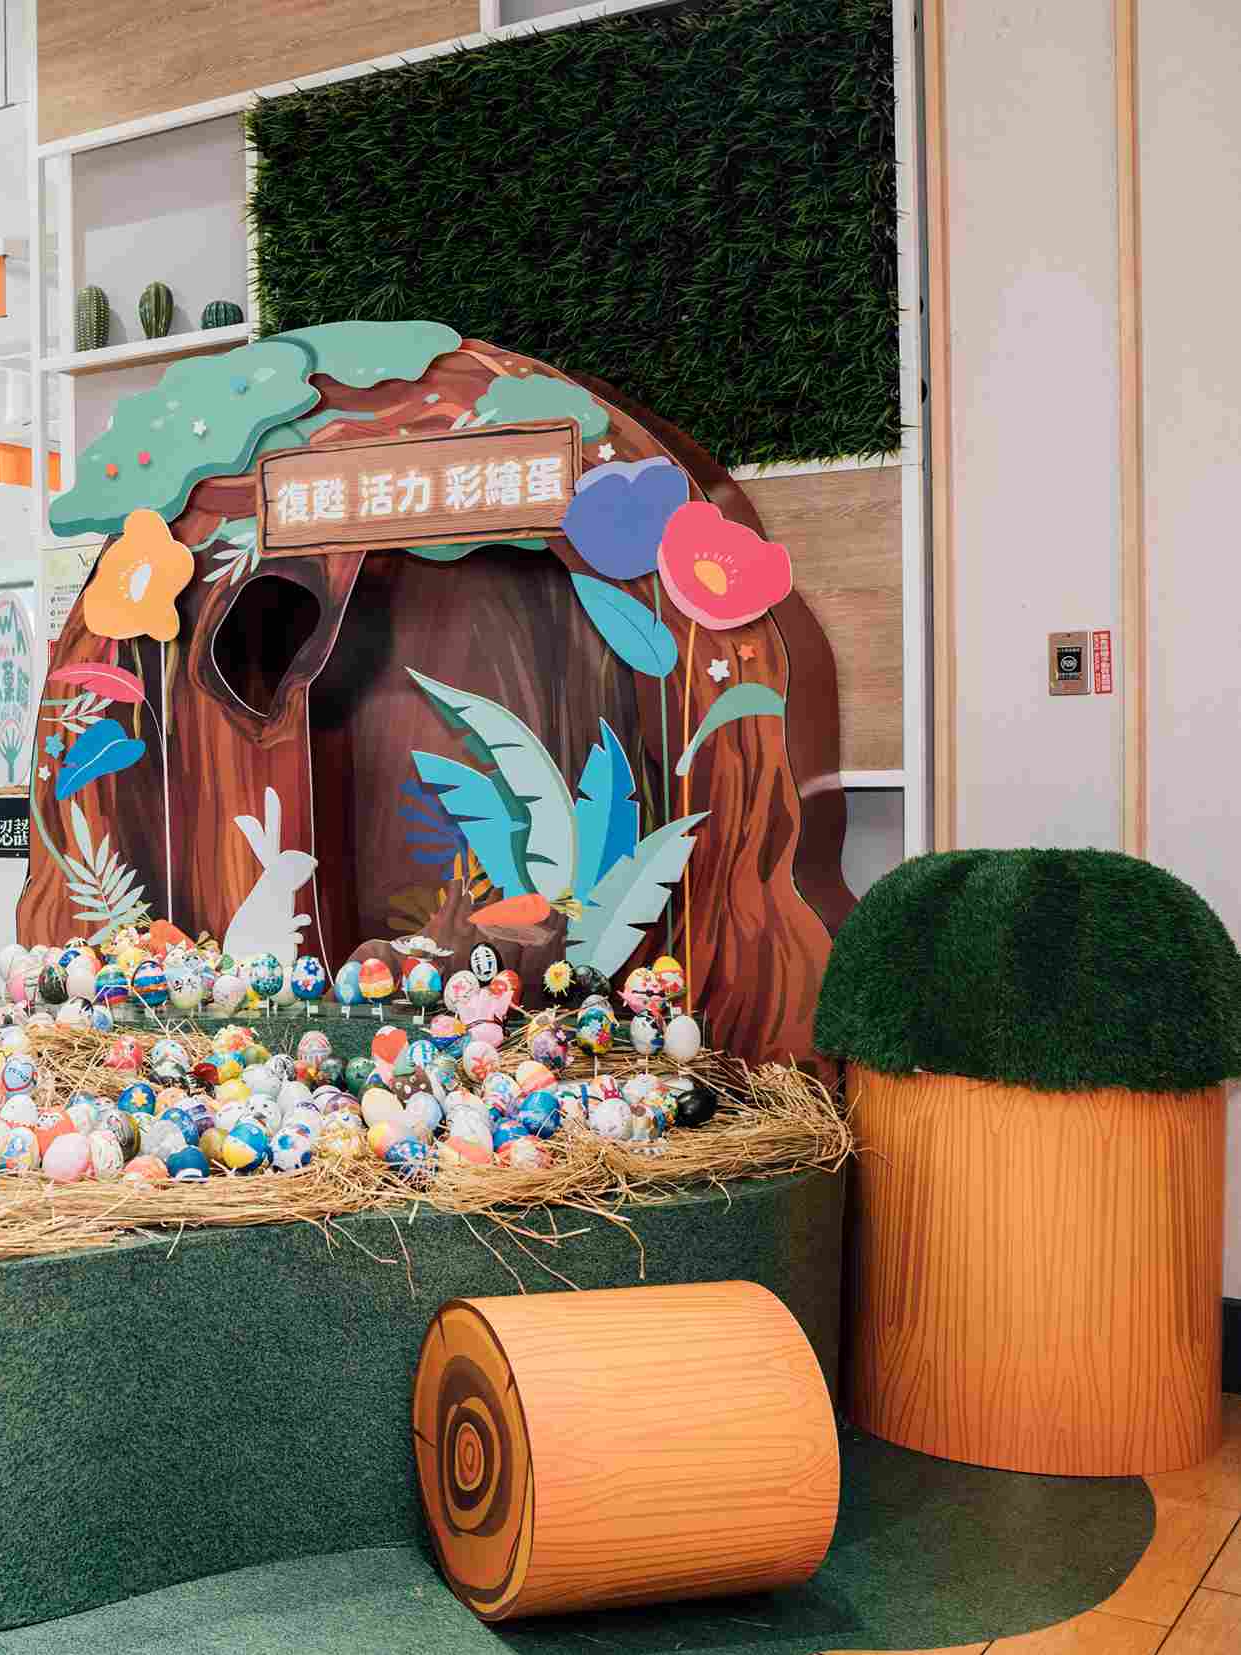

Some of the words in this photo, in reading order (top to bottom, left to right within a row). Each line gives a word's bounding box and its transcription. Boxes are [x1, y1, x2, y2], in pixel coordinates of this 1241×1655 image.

[359, 470, 433, 517] 活力
[444, 457, 564, 509] 彩繪蛋
